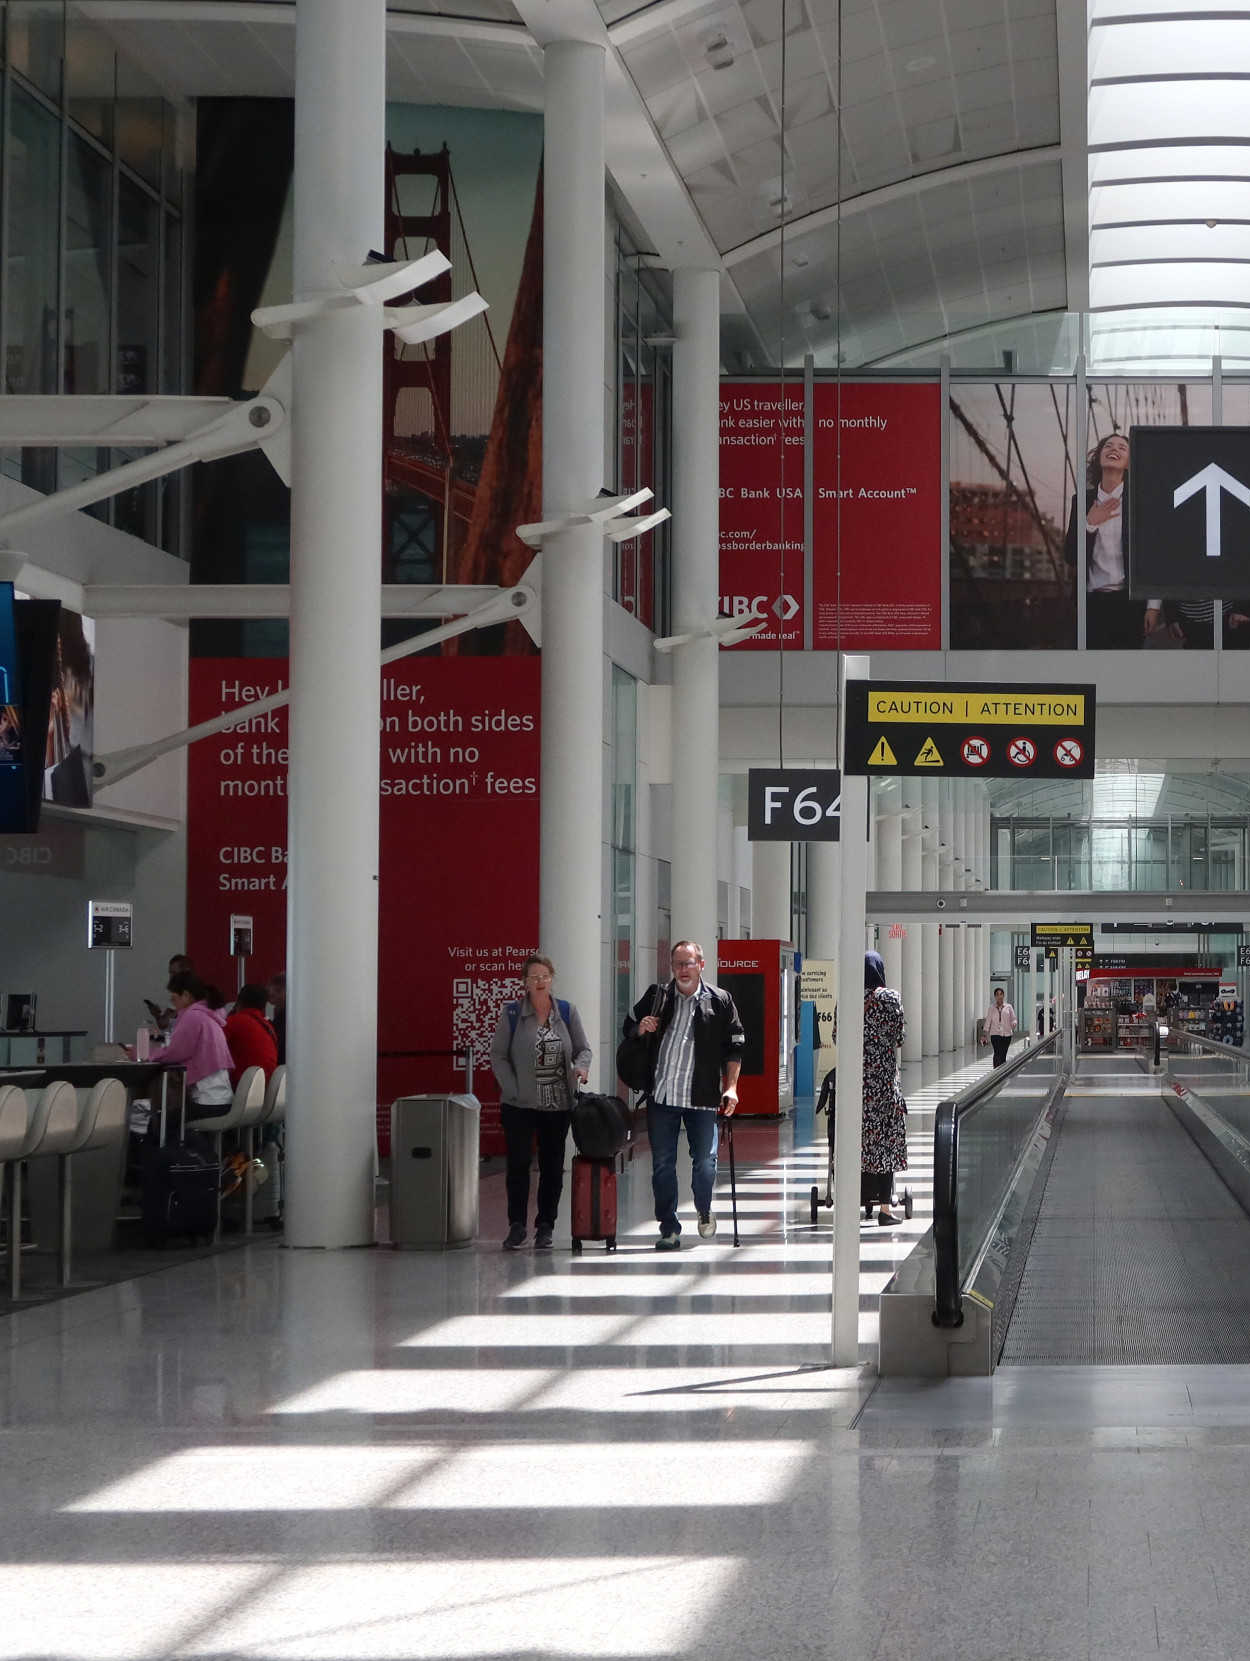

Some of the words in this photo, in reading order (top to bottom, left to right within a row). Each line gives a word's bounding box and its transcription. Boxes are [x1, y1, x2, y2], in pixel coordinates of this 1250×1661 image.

[718, 400, 730, 413] ey
[733, 399, 751, 411] US
[718, 416, 736, 428] nk
[738, 417, 776, 428] easier
[779, 416, 805, 428] with
[818, 418, 834, 428] no
[838, 416, 888, 431] monthly
[718, 431, 778, 446] ansaction†
[718, 487, 734, 499] BC
[740, 487, 770, 499] Bank
[776, 487, 803, 499] USA
[818, 487, 853, 499] Smart
[718, 528, 757, 539] c.com/
[719, 595, 768, 618] IBC
[752, 630, 776, 640] made
[221, 680, 270, 702] Hey
[382, 678, 425, 705] ller,
[876, 700, 953, 715] CAUTION
[980, 702, 1077, 717] ATTENTION
[408, 709, 463, 732] both
[470, 708, 534, 731] sides
[220, 742, 244, 765] of
[251, 742, 288, 764] the
[388, 740, 441, 763] with
[450, 747, 480, 763] no
[220, 774, 288, 796] mont
[380, 771, 478, 795] saction†
[485, 772, 536, 794] fees
[219, 846, 265, 864] CIBC
[271, 847, 288, 864] Ba
[219, 873, 276, 890] Smart
[448, 946, 473, 957] Visit
[476, 948, 489, 957] us
[491, 946, 502, 957] at
[505, 945, 540, 957] Pears
[1017, 947, 1030, 956] E6
[465, 963, 477, 972] or
[479, 963, 505, 972] scan
[508, 960, 523, 971] he
[1017, 957, 1030, 965] F6
[1075, 969, 1090, 980] RELAY
